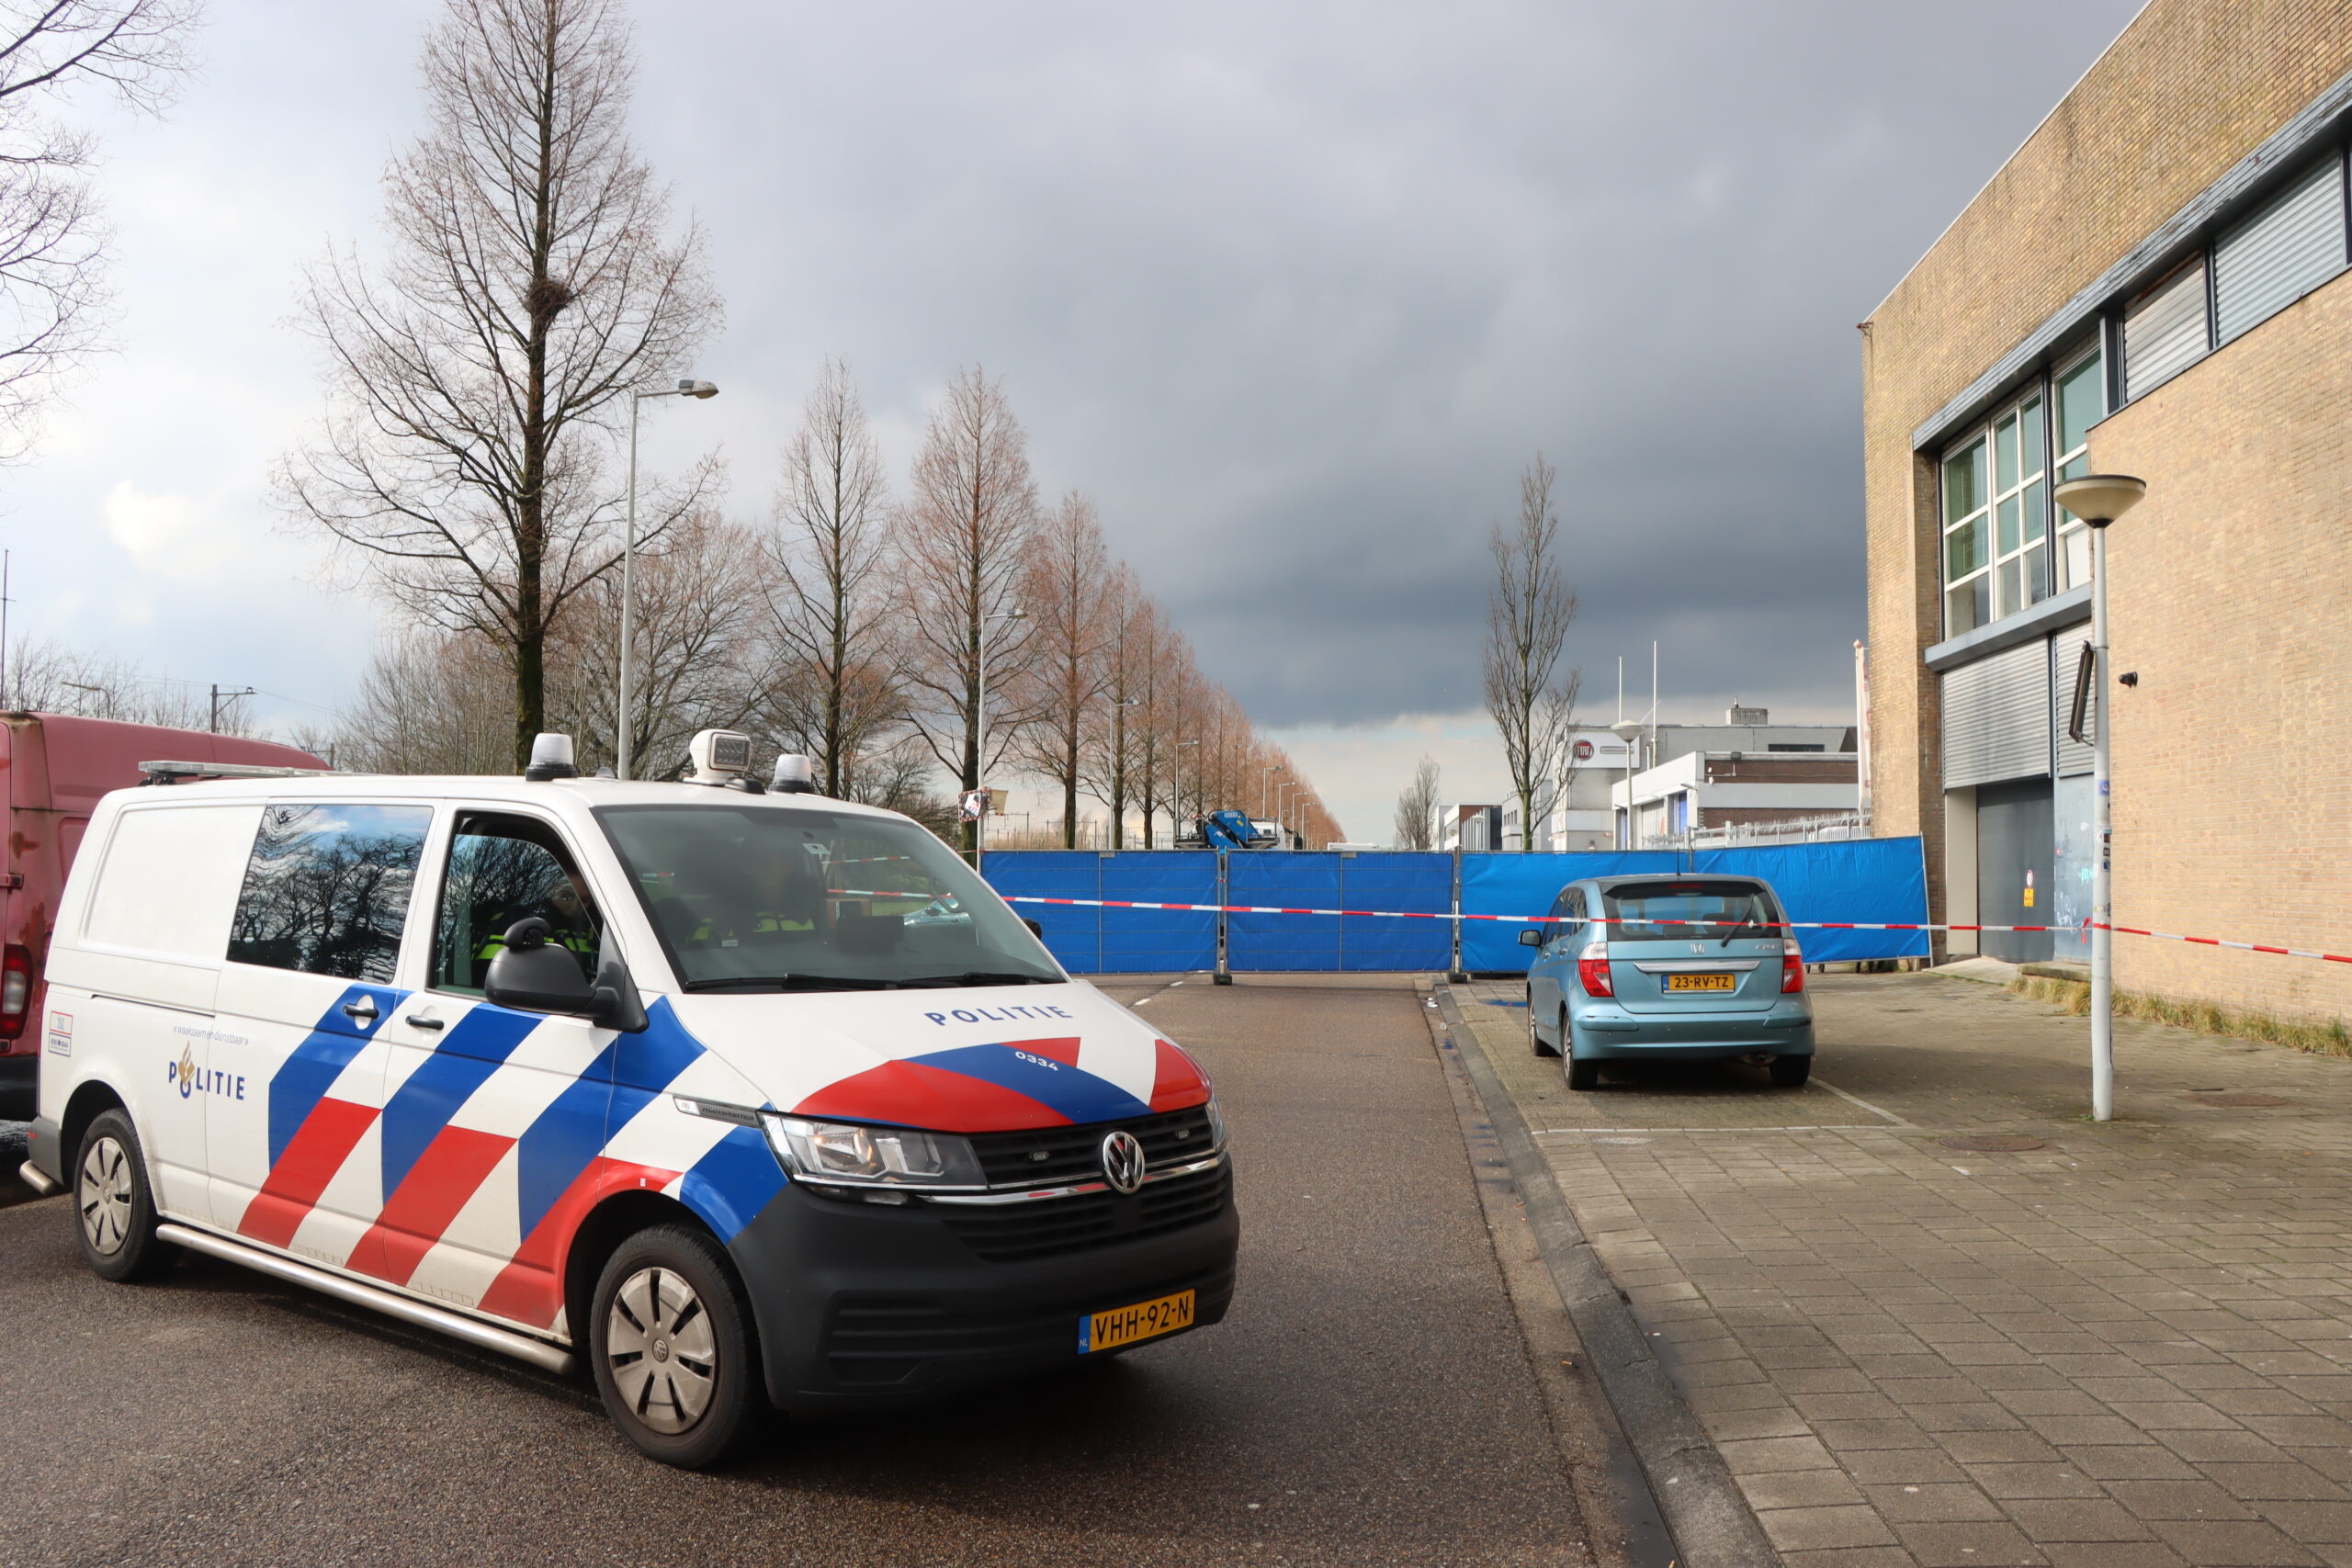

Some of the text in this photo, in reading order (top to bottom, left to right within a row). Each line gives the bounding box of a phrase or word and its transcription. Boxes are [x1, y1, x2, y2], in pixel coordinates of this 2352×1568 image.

[1674, 976, 1729, 988] 23-RV-TZ
[924, 1006, 1074, 1026] POLITIE
[1014, 1051, 1059, 1072] 0334
[168, 1061, 245, 1100] POLITIE
[1095, 1295, 1190, 1345] VHH-92-N
[1079, 1338, 1089, 1348] NL
